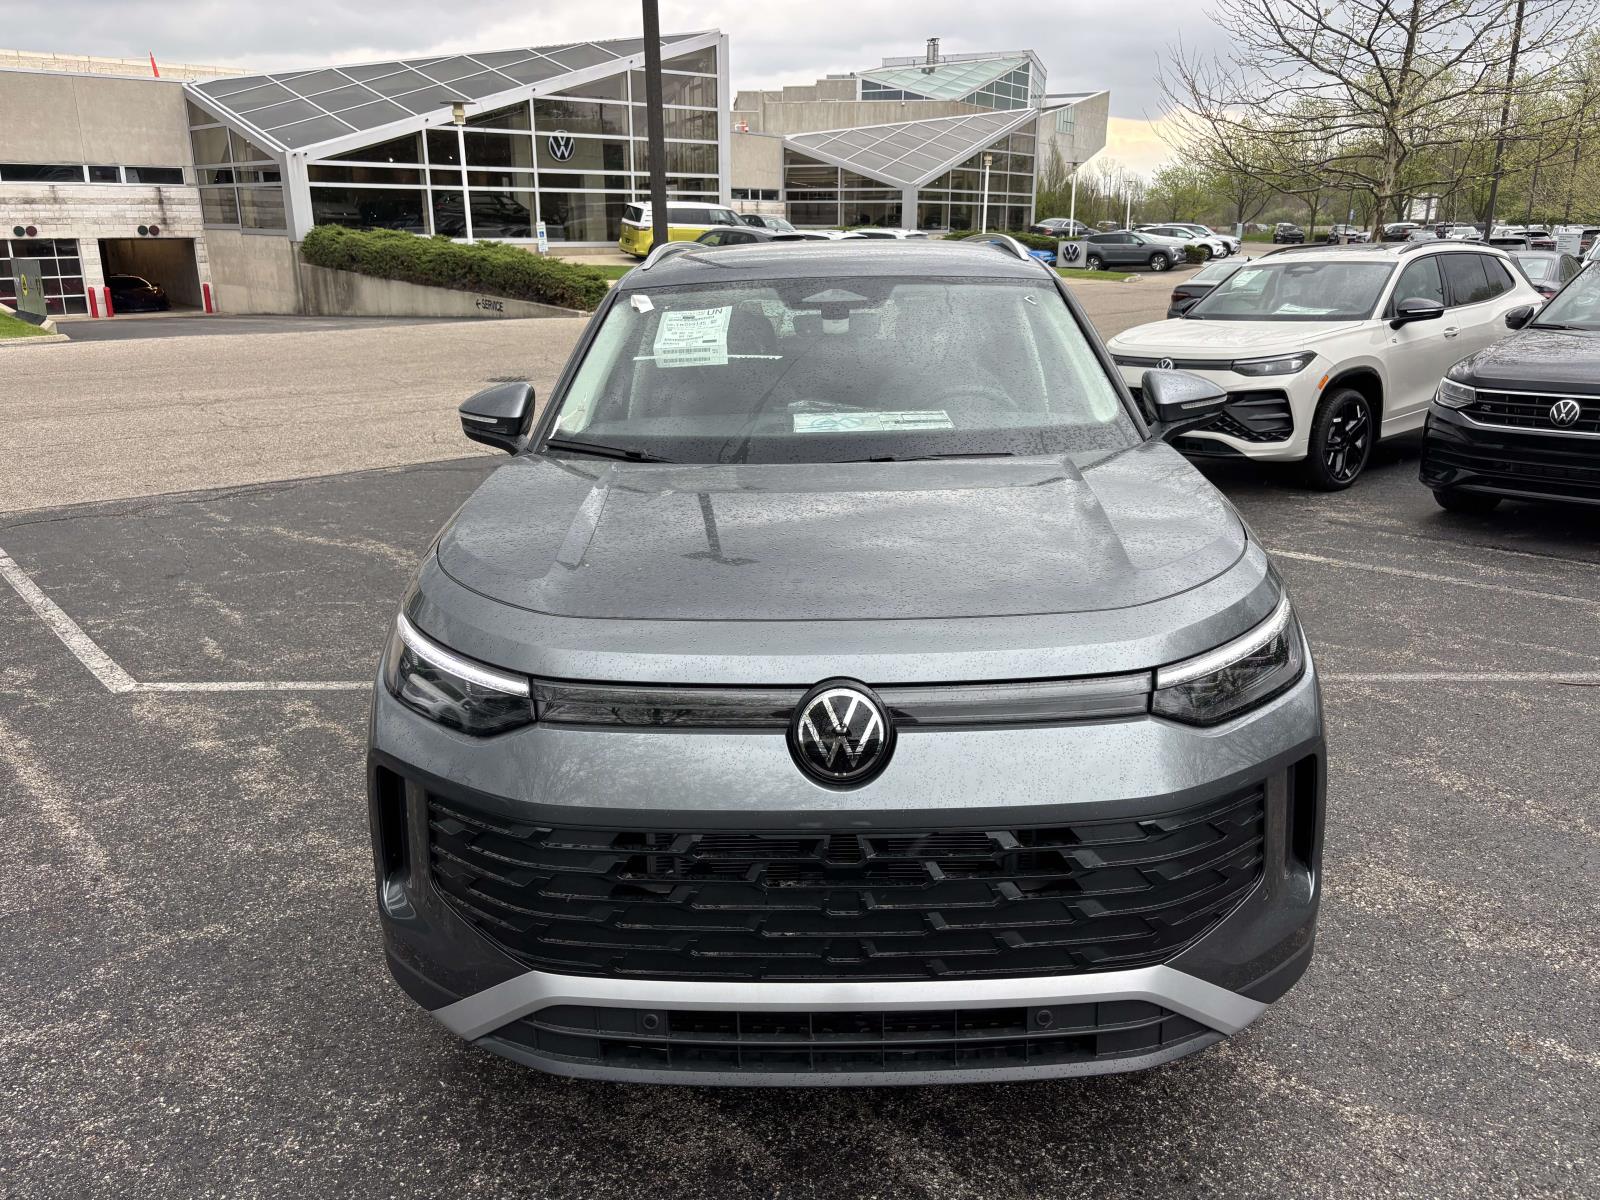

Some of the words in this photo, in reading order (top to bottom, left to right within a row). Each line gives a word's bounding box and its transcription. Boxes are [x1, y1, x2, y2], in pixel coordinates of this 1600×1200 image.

[481, 298, 504, 312] SERVICE
[707, 308, 723, 316] UN
[1549, 399, 1580, 427] VW
[797, 688, 885, 776] VW
